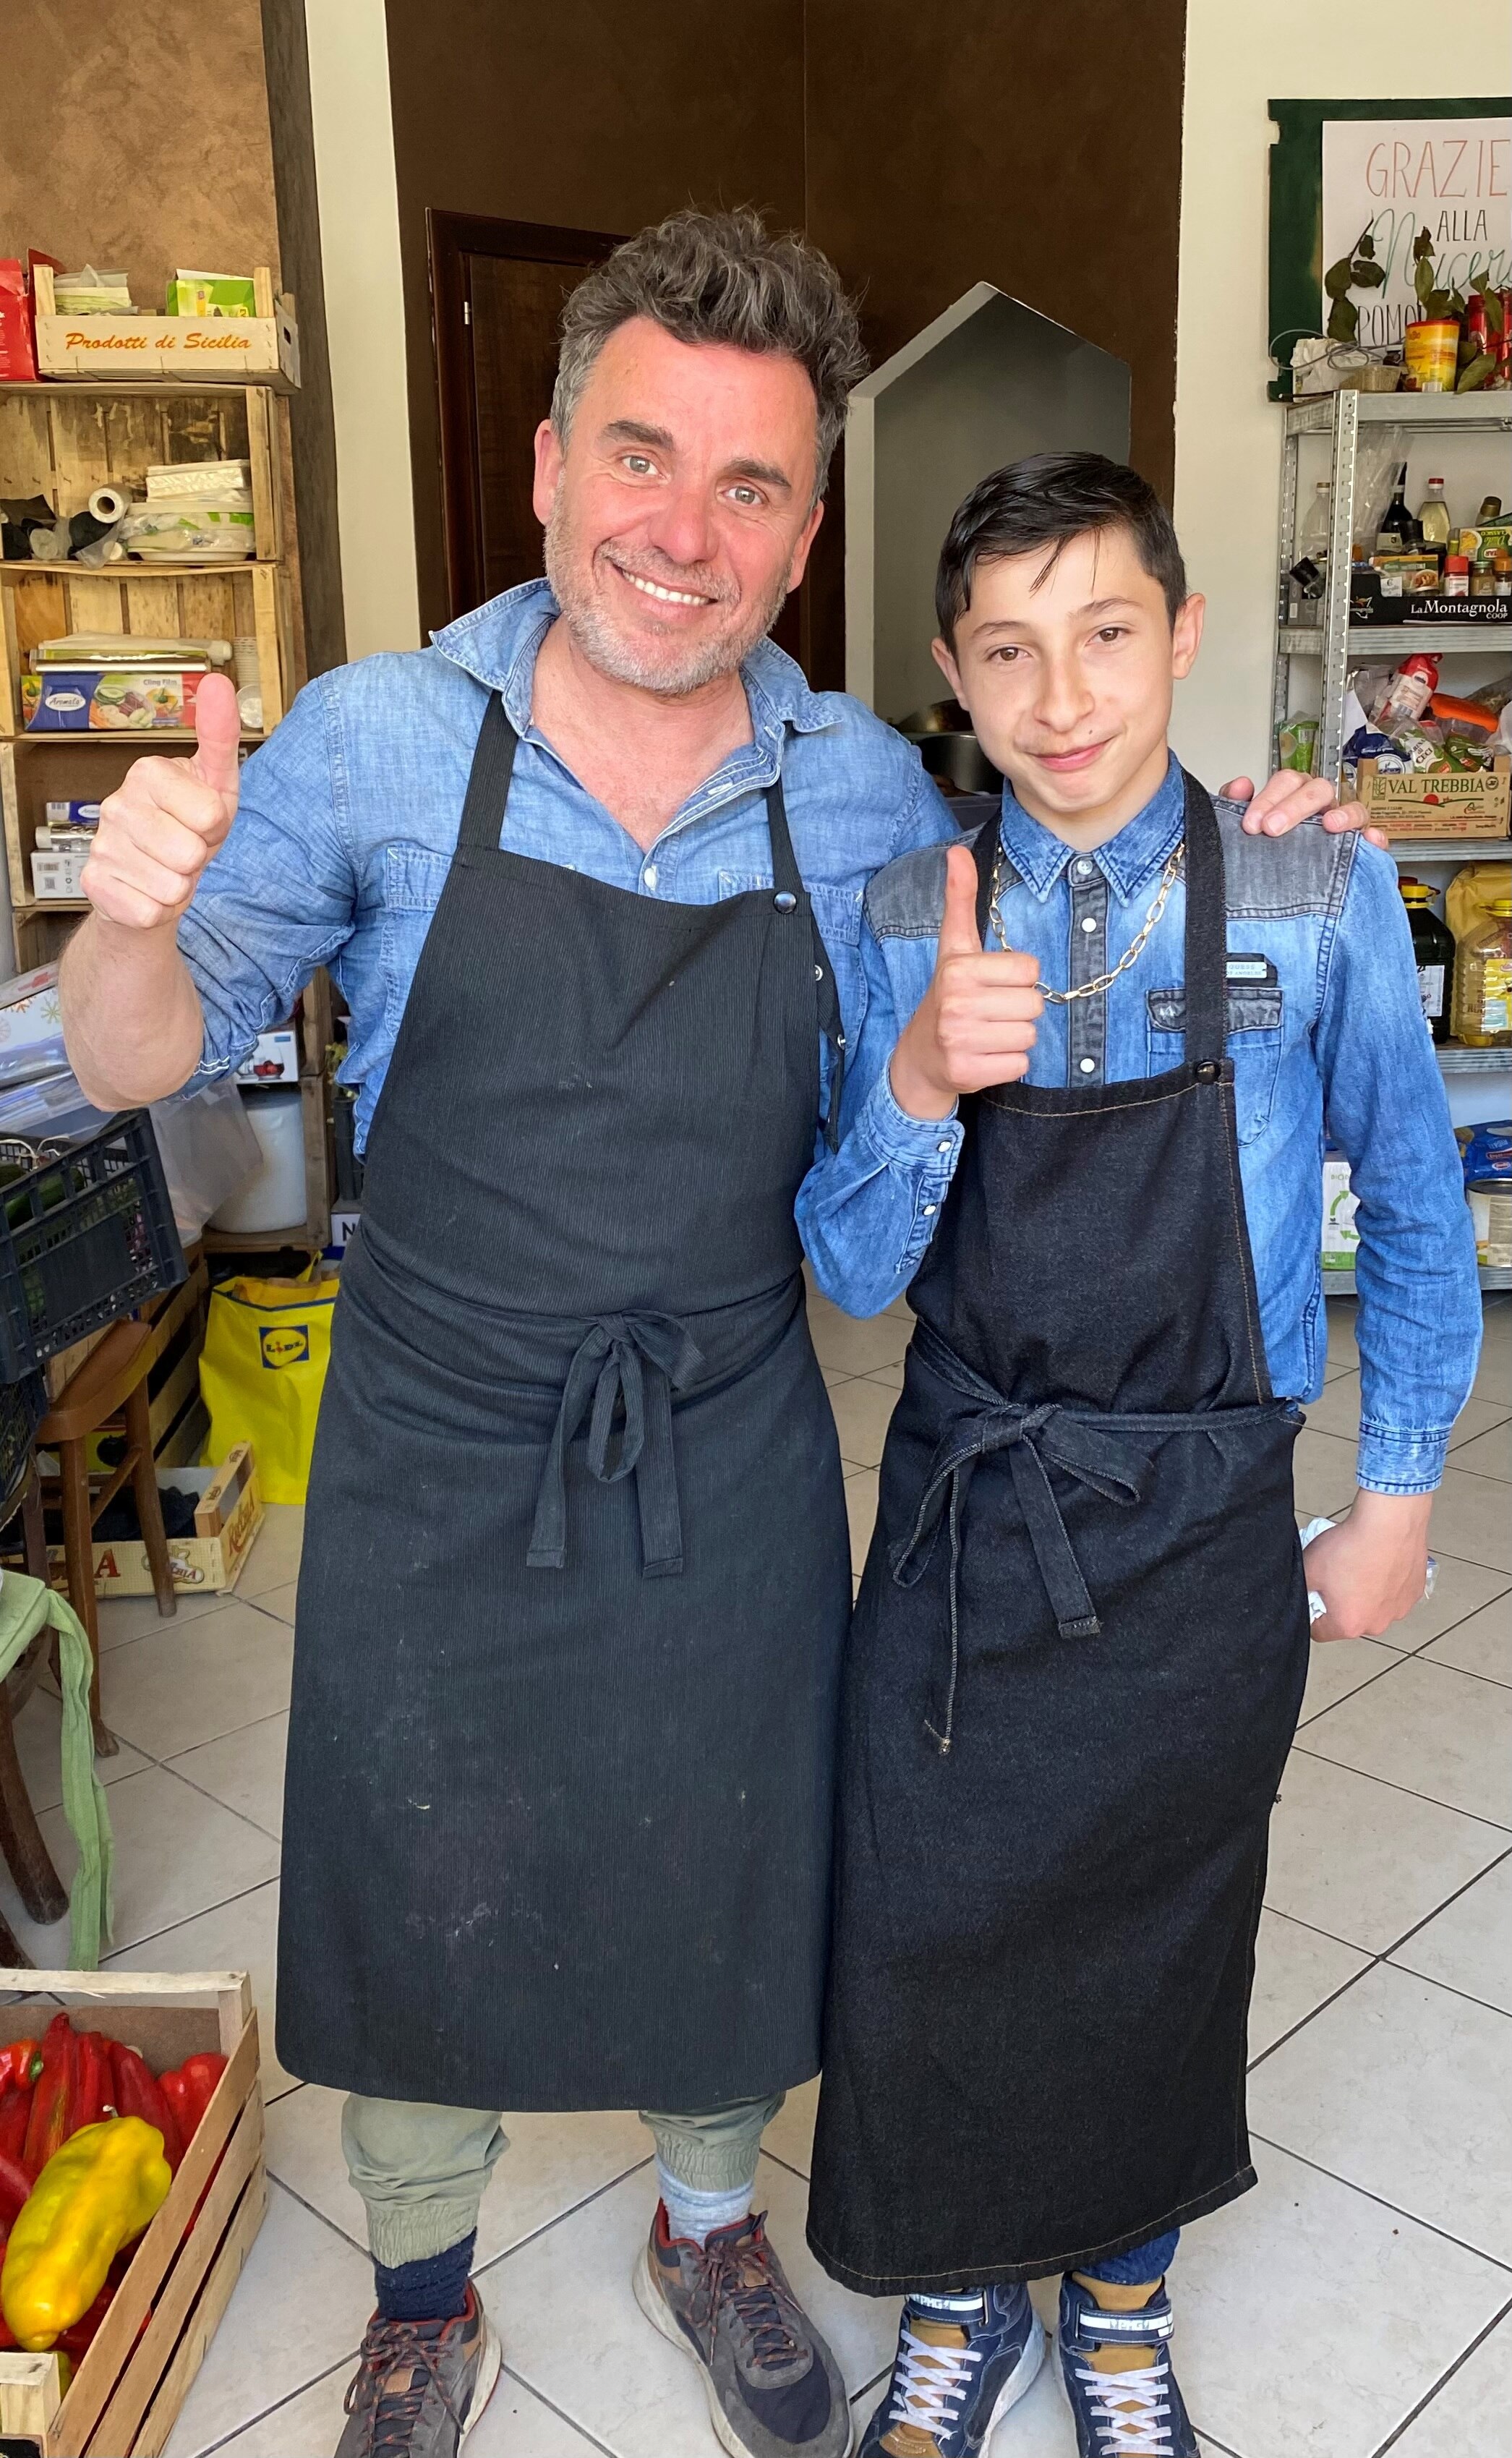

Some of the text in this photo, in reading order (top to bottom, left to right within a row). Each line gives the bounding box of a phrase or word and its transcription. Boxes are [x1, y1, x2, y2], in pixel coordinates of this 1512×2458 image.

[1366, 139, 1511, 198] GRAZIE
[1436, 209, 1488, 242] ALLA
[65, 332, 252, 350] Prodotti di Sicilia
[1423, 598, 1508, 617] Montagnola
[1415, 748, 1432, 764] CECI
[1388, 777, 1485, 794] VAL TREBBIA
